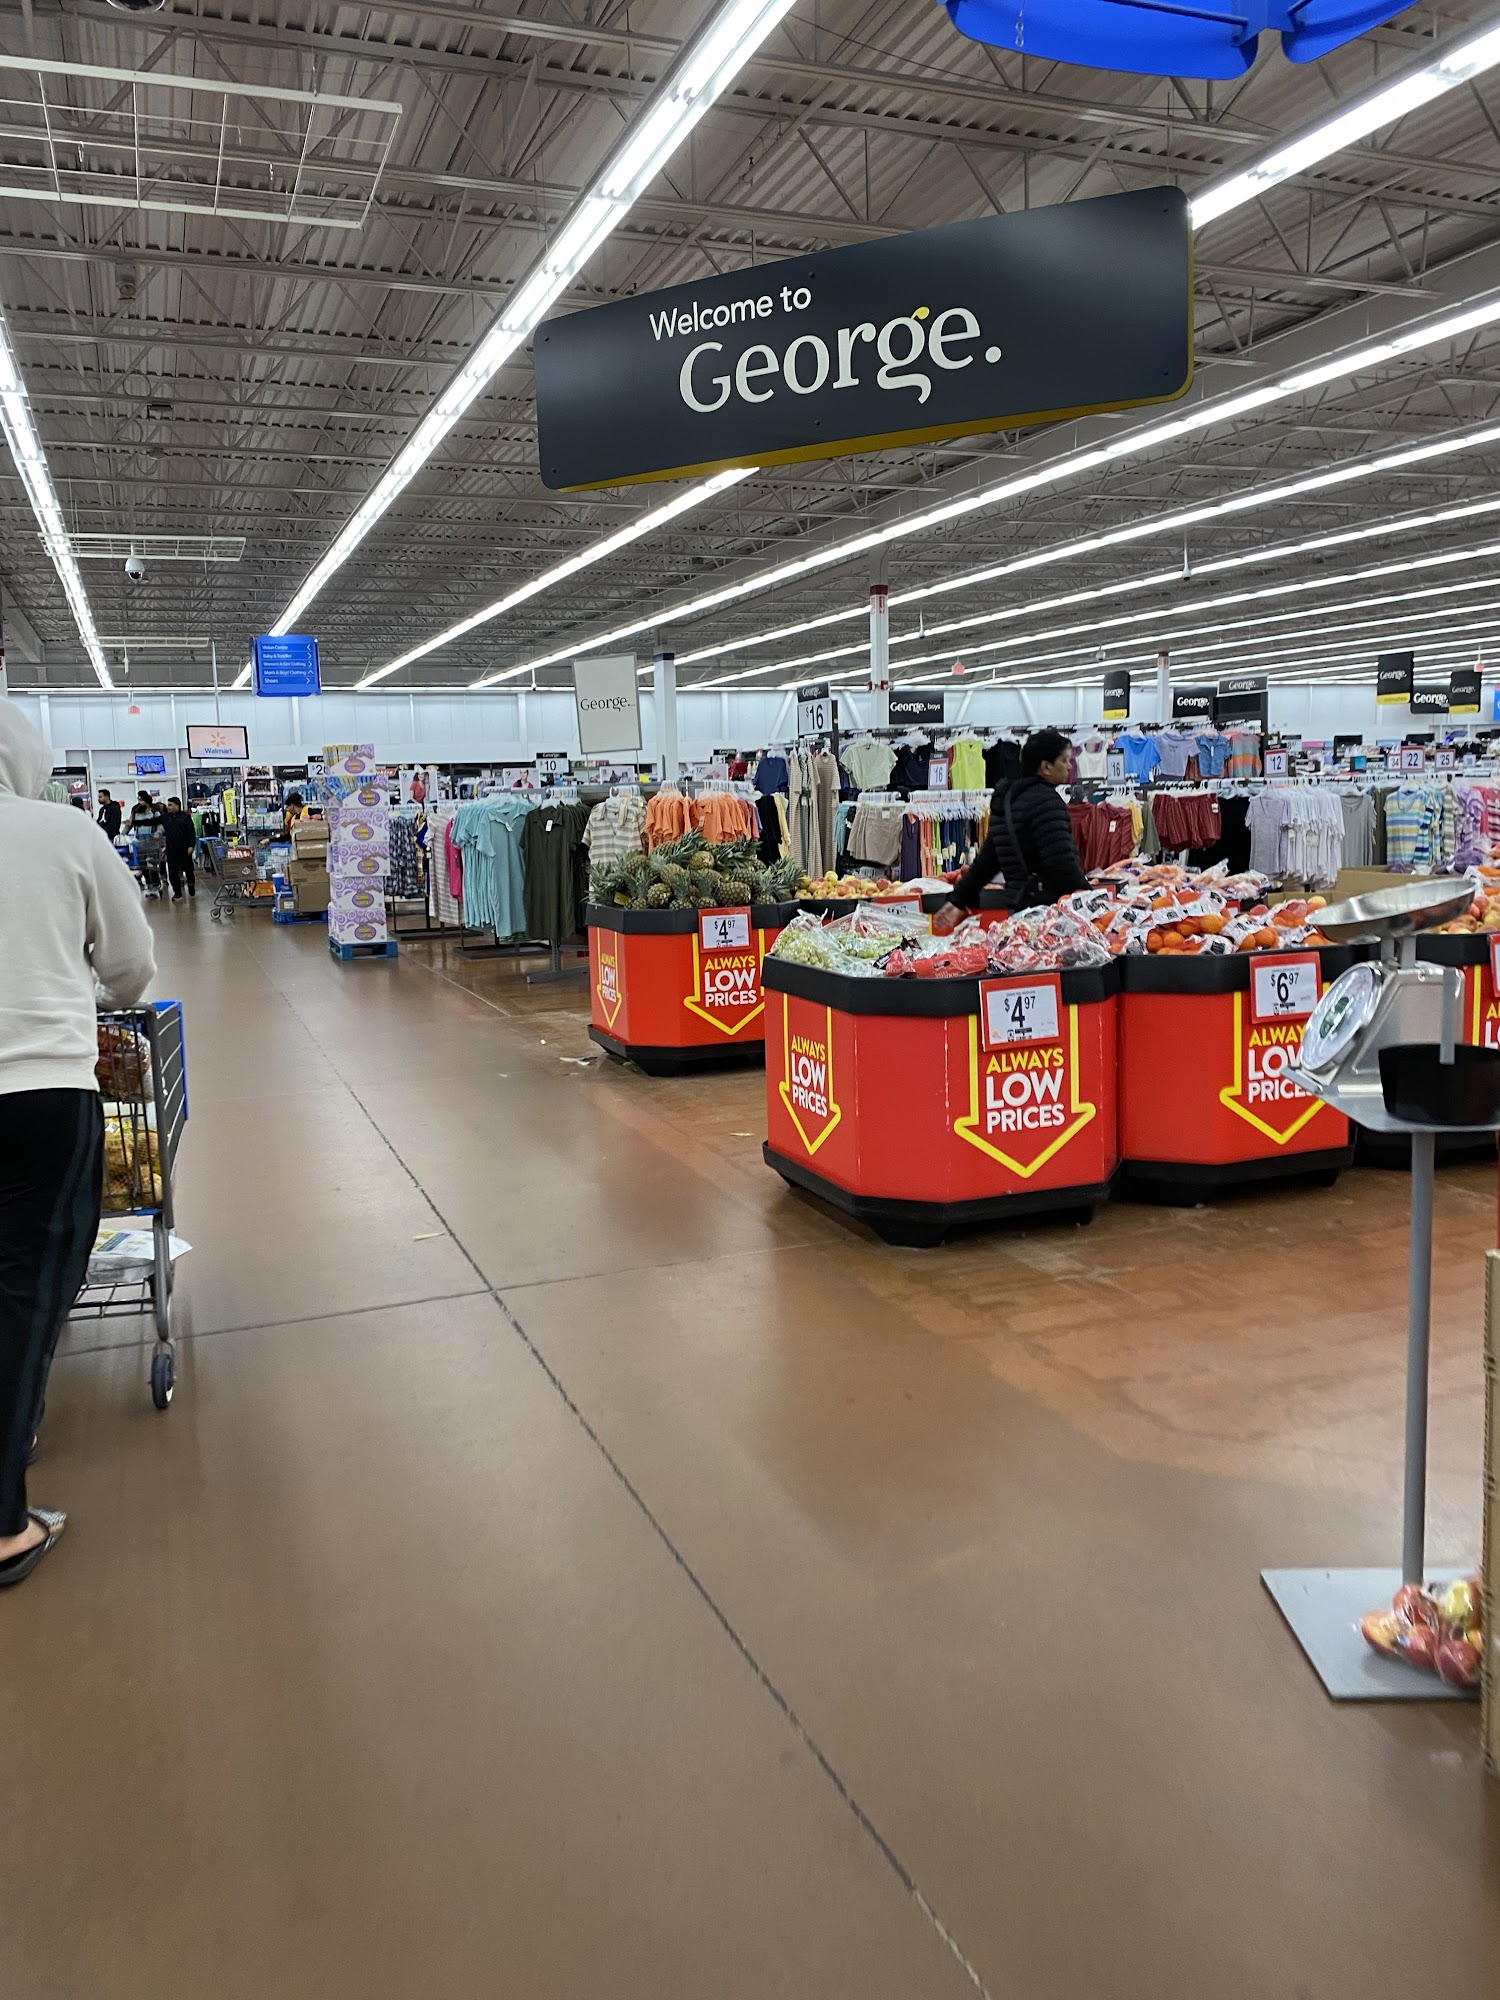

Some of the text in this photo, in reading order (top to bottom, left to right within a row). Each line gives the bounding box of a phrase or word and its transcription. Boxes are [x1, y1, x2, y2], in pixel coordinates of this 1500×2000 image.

[650, 286, 812, 341] Welcome to
[679, 306, 1002, 414] George.
[580, 696, 631, 713] George.
[927, 703, 941, 711] boys
[601, 953, 615, 968] ALWAYS
[705, 956, 756, 971] ALWAYS
[601, 964, 616, 989] LOW
[704, 968, 756, 993] LOW
[602, 984, 617, 1003] PRICES
[705, 990, 757, 1008] PRICES
[791, 1035, 826, 1062] ALWAYS
[1249, 1024, 1306, 1048] ALWAY
[791, 1053, 826, 1093] LOW
[986, 1048, 1064, 1075] ALWAYS
[792, 1084, 828, 1118] PRICES
[986, 1068, 1064, 1109] LOW
[1248, 1079, 1313, 1103] PRICE
[986, 1103, 1065, 1134] PRICES
